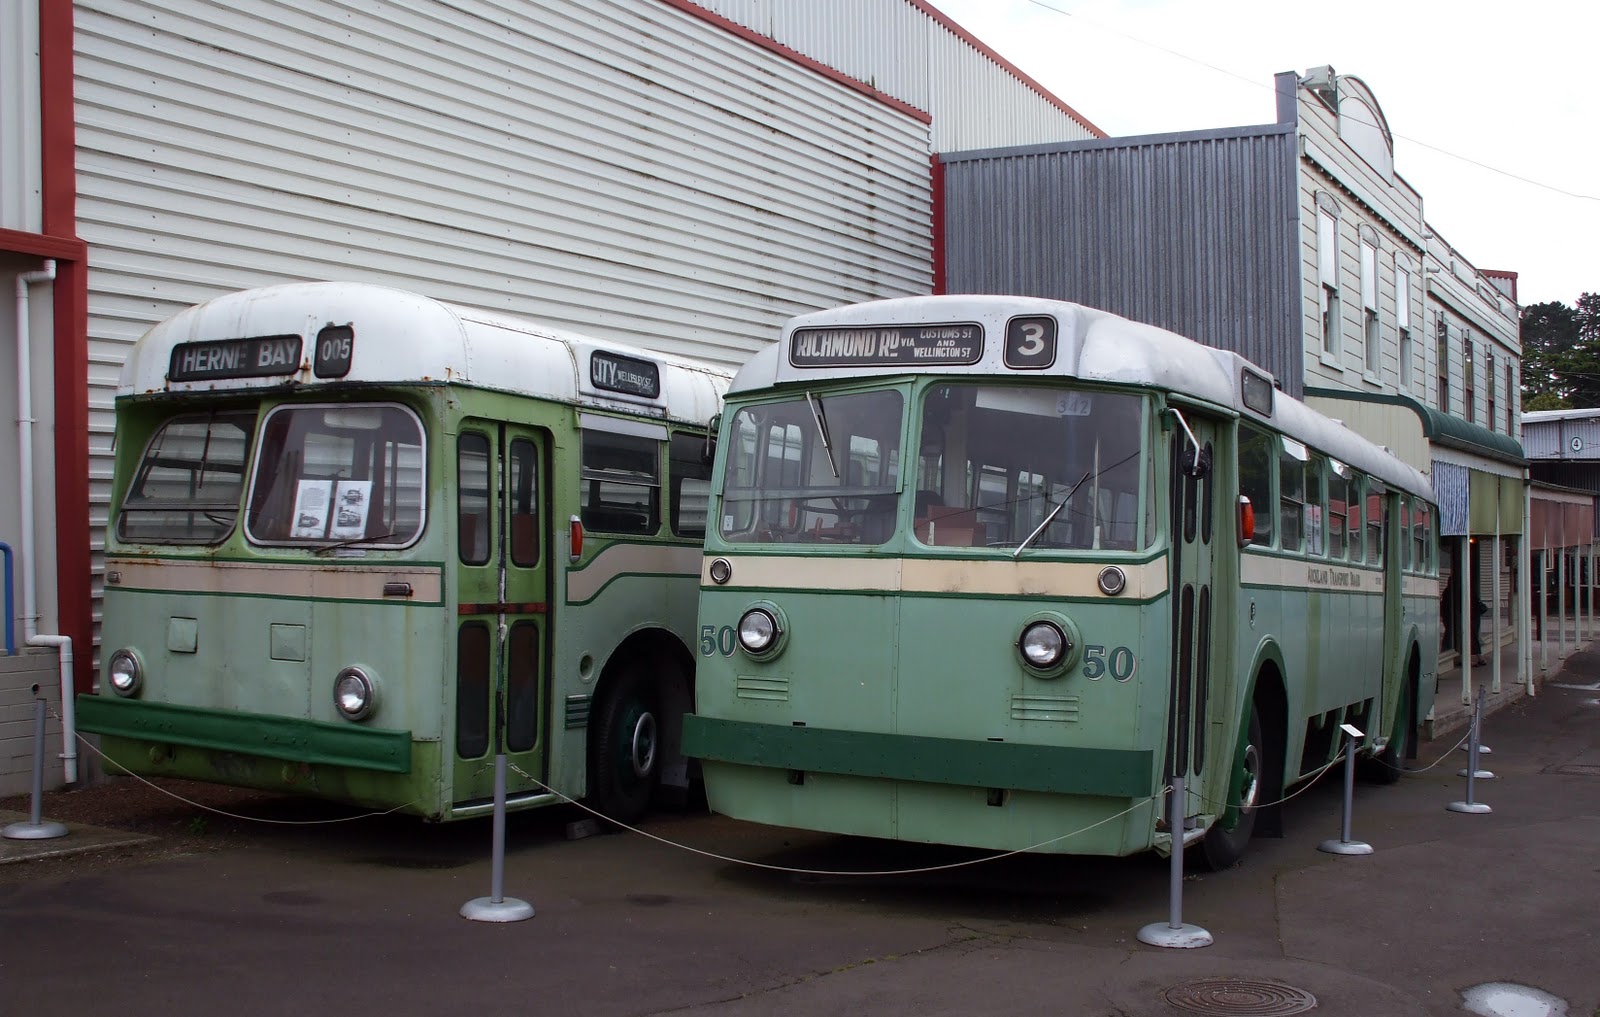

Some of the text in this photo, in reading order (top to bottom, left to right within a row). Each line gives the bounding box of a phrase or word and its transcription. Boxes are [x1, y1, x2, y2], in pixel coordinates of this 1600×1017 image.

[796, 329, 915, 357] RICHMOND RD VIA
[920, 327, 960, 339] CUSTOMS
[1017, 323, 1046, 356] 3
[257, 338, 298, 368] BAY
[321, 338, 351, 362] 005
[913, 347, 960, 358] WELLINGTON
[592, 356, 617, 386] CITY
[1573, 439, 1579, 448] 4
[700, 625, 738, 658] 50
[1082, 645, 1137, 683] 50
